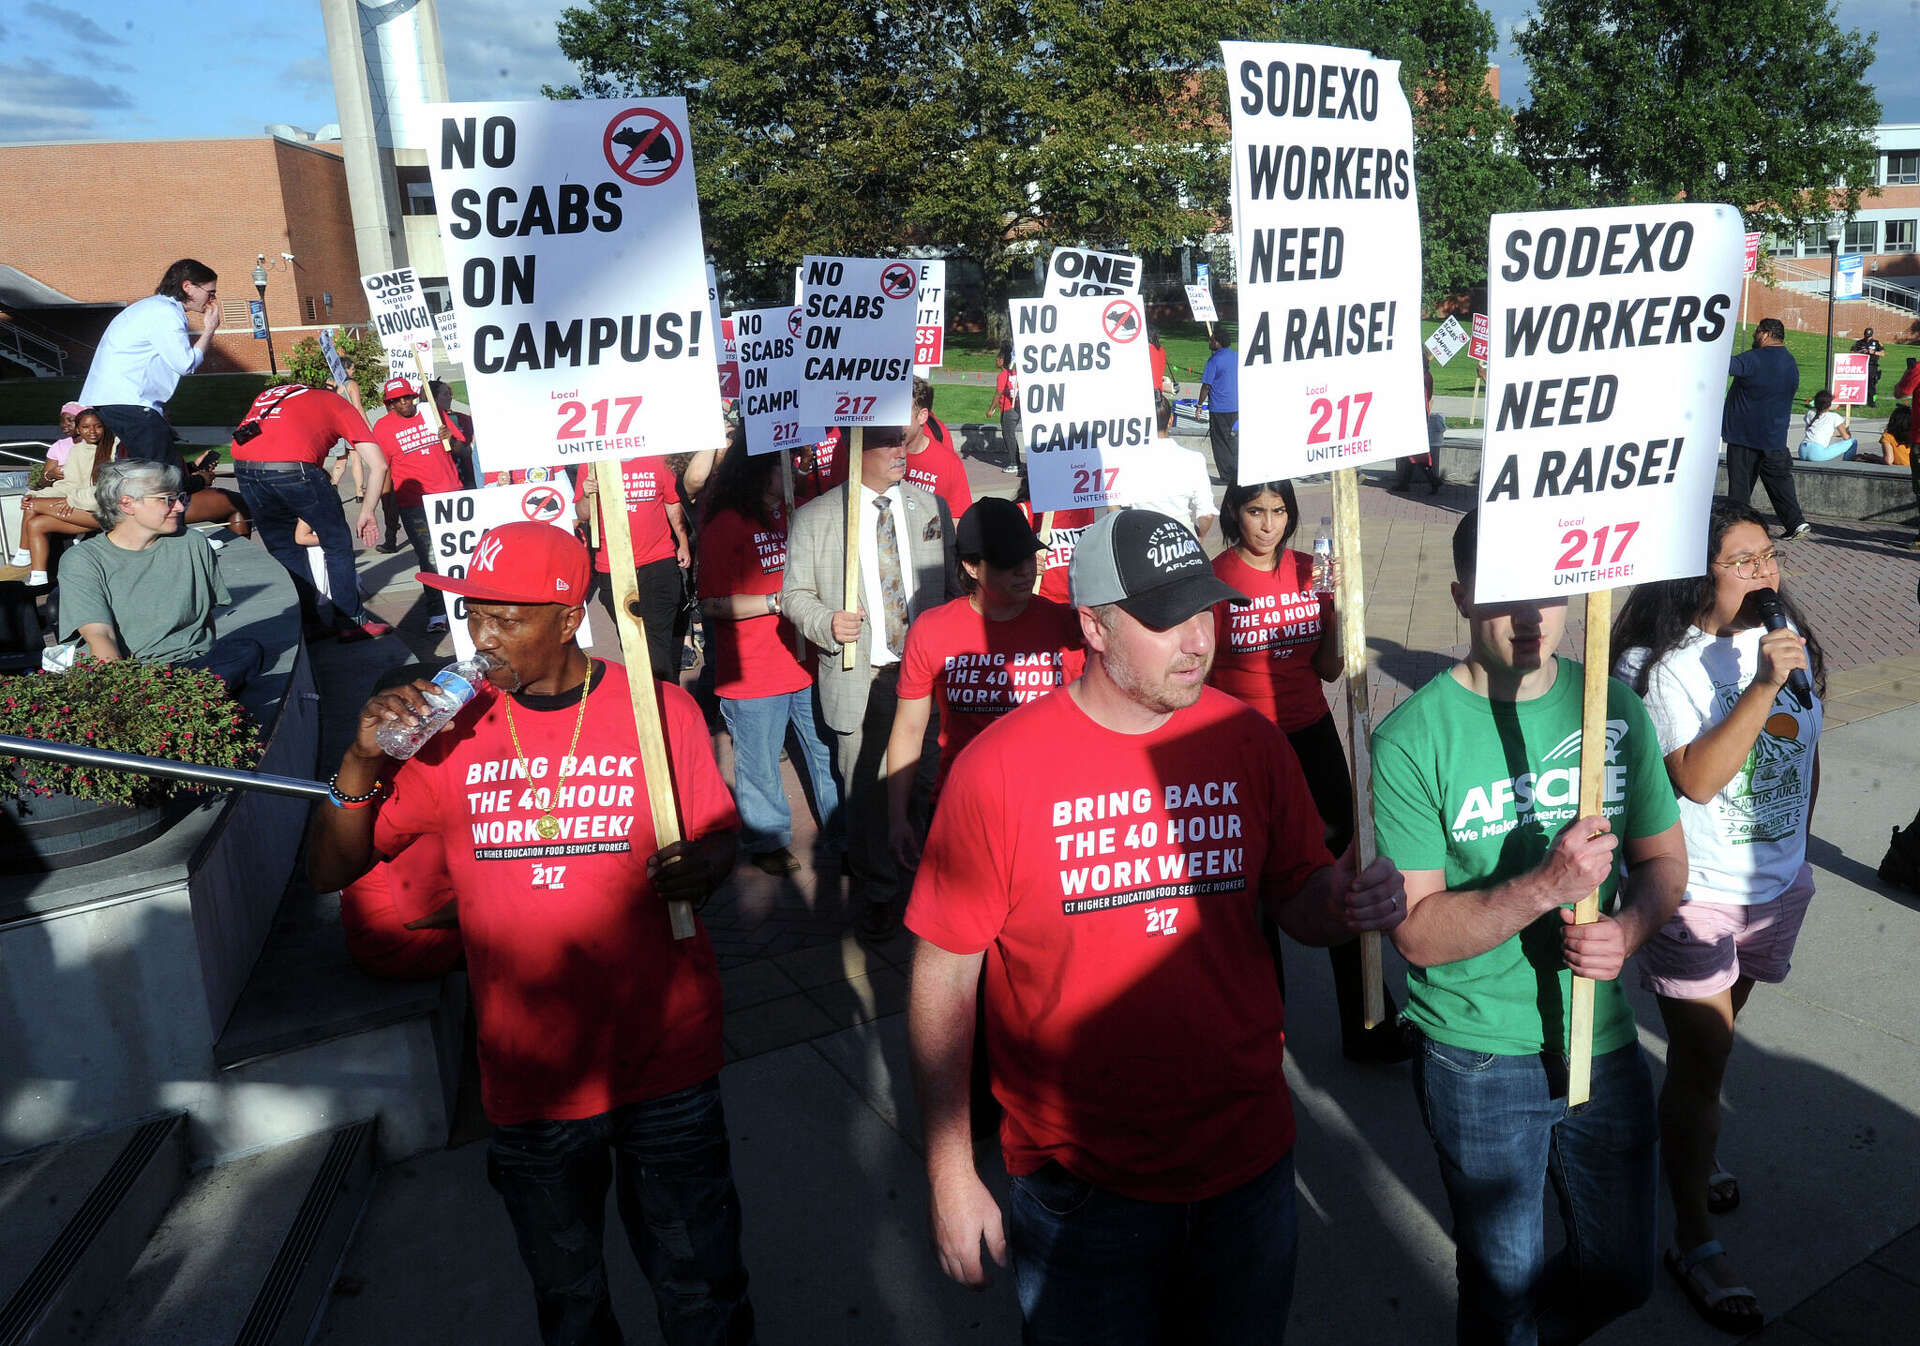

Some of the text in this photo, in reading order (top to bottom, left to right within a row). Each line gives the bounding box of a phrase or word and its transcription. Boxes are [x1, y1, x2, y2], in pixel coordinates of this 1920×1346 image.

[1240, 60, 1378, 121] SODEXO
[441, 116, 516, 169] NO
[1249, 144, 1409, 200] WORKERS
[450, 182, 622, 239] SCABS
[1249, 227, 1344, 284] NEED
[1502, 221, 1694, 282] SODEXO
[366, 270, 415, 290] ONE
[463, 254, 536, 308] ON
[807, 262, 843, 286] NO
[1054, 251, 1136, 287] ONE
[376, 285, 414, 299] JOB
[383, 295, 412, 304] SHOULD
[806, 294, 884, 319] SCABS
[1019, 304, 1058, 334] NO
[377, 306, 430, 336] ENOUGH
[738, 314, 762, 336] NO
[1439, 329, 1447, 337] ON
[1443, 323, 1458, 340] SCABS
[1449, 318, 1456, 326] NO
[1476, 316, 1487, 325] WE
[1505, 294, 1730, 358] WORKERS
[474, 311, 702, 374] CAMPUS!
[805, 325, 841, 349] ON
[1245, 301, 1396, 366] A RAISE!
[1434, 334, 1453, 357] CAMPUS!
[741, 338, 794, 363] SCABS
[1022, 341, 1111, 374] SCABS
[744, 367, 768, 390] ON
[804, 357, 910, 381] CAMPUS!
[551, 389, 578, 399] Local
[1027, 383, 1065, 413] ON
[1306, 384, 1328, 396] Local
[1496, 374, 1618, 431] NEED
[556, 396, 643, 439] 217
[835, 396, 877, 414] 217
[1307, 391, 1373, 446] 217
[773, 422, 799, 441] 217
[1031, 417, 1152, 453] CAMPUS!
[909, 469, 938, 483] BACK
[1073, 467, 1120, 494] 217
[1486, 437, 1684, 502] A RAISE!
[435, 496, 474, 524] NO
[1558, 517, 1585, 527] Local
[1149, 527, 1164, 545] IT'S
[1554, 521, 1640, 571] 217
[757, 543, 778, 555] THE
[1147, 537, 1200, 567] Union
[1166, 559, 1203, 574] AFL-CIO
[1280, 590, 1318, 605] BACK
[1232, 614, 1260, 628] THE
[1264, 611, 1280, 624] 40
[1231, 627, 1279, 645] WORK
[945, 652, 1063, 671] BRING BACK
[946, 670, 1063, 686] THE 40 HOUR
[947, 688, 1002, 703] WORK
[465, 756, 637, 785] BRING BACK
[467, 785, 635, 815] THE 40 HOUR
[1053, 782, 1238, 827] BRING BACK
[1731, 793, 1772, 809] CACTUS
[1774, 783, 1800, 800] JUICE
[472, 816, 634, 844] WORK WEEK!
[1056, 814, 1242, 861] THE 40 HOUR
[1452, 809, 1577, 843] We Make America
[484, 849, 503, 859] HIGHER
[504, 847, 543, 858] EDUCATION
[545, 846, 564, 855] FOOD
[566, 844, 596, 854] SERVICE
[532, 866, 566, 885] 217
[1060, 848, 1243, 895] WORK WEEK!
[1065, 879, 1245, 913] CT HIGHER EDUCATION FOOD SERVICE WORKERS
[1146, 908, 1179, 933] 217
